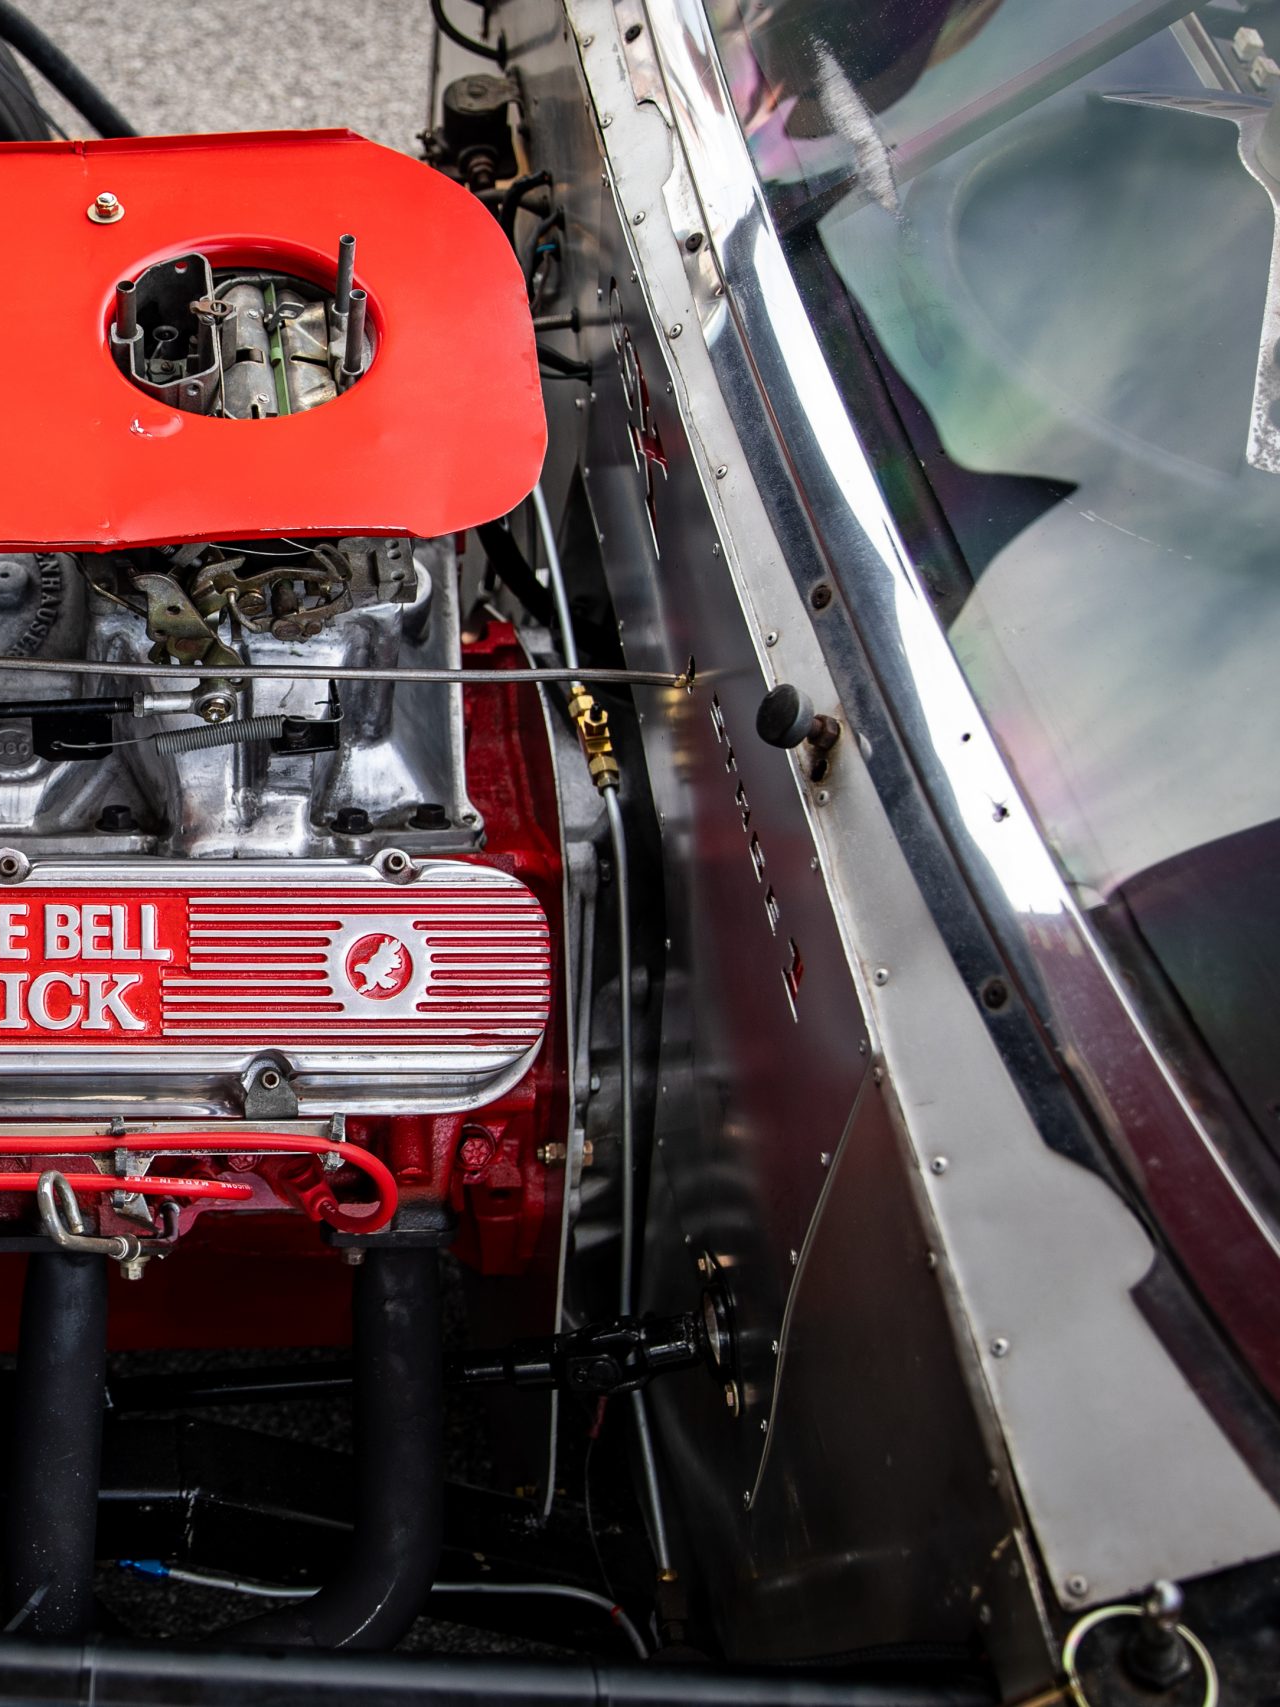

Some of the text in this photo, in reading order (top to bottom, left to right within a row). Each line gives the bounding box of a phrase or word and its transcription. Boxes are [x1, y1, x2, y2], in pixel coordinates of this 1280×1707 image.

[44, 903, 173, 961] BELL
[780, 936, 805, 1024] 1
[178, 1177, 209, 1187] MADE
